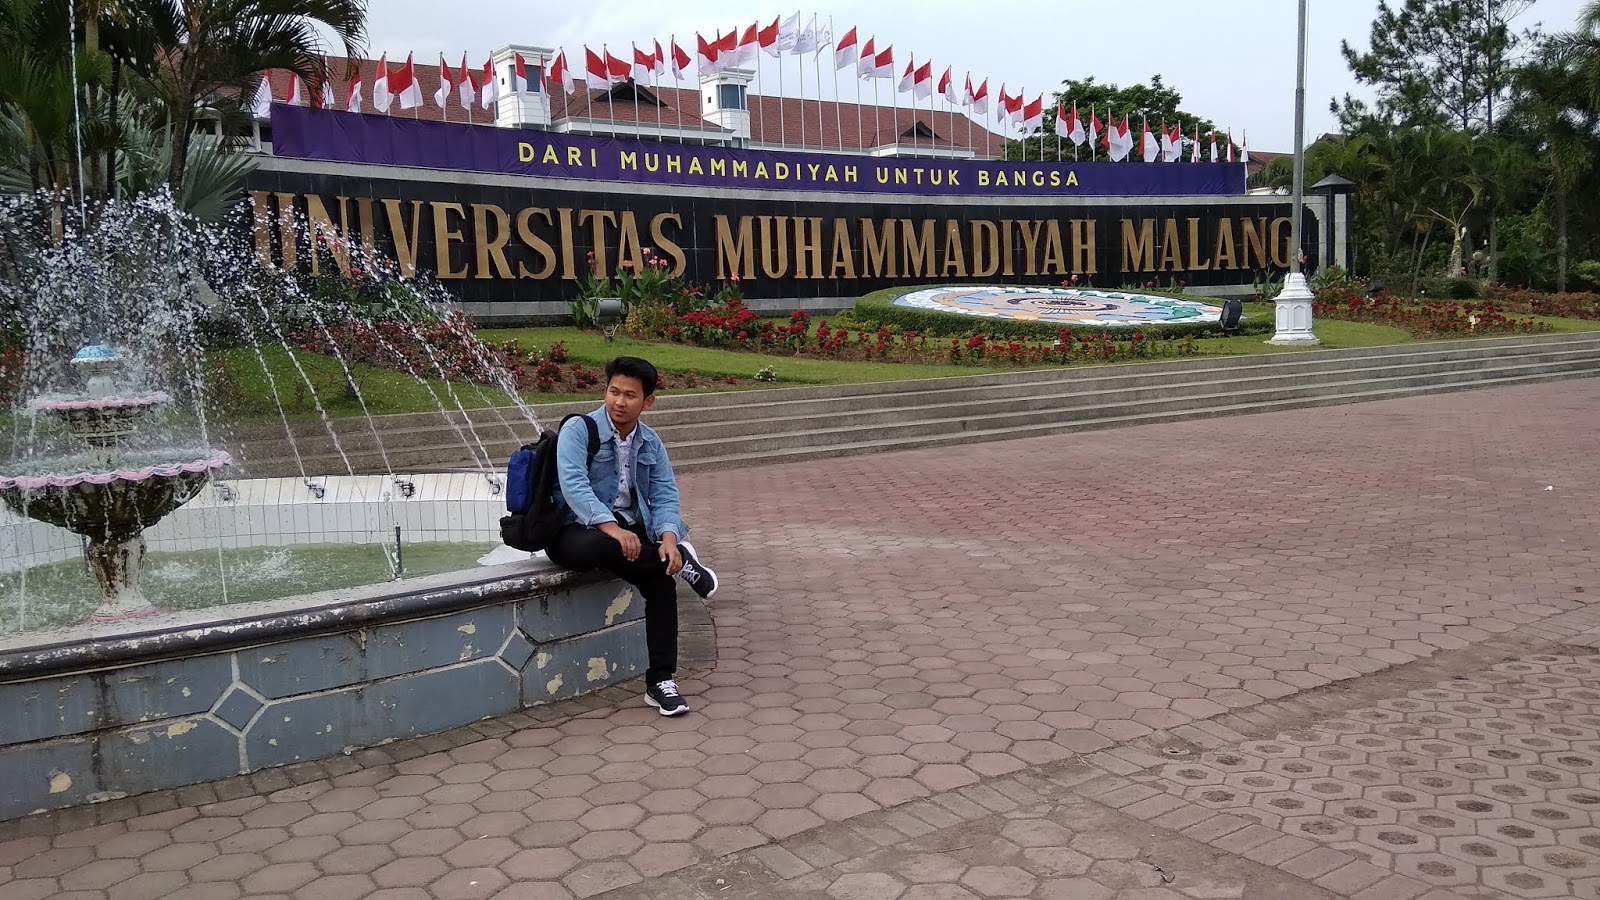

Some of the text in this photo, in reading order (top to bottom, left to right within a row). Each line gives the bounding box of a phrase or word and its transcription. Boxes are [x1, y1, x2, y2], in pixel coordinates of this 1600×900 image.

[518, 142, 1079, 187] DARI MUHAMMADIYAH UNTUK BANGSA
[248, 190, 1293, 281] UNIVERSITAS MUHAMMADIYAH MALANG
